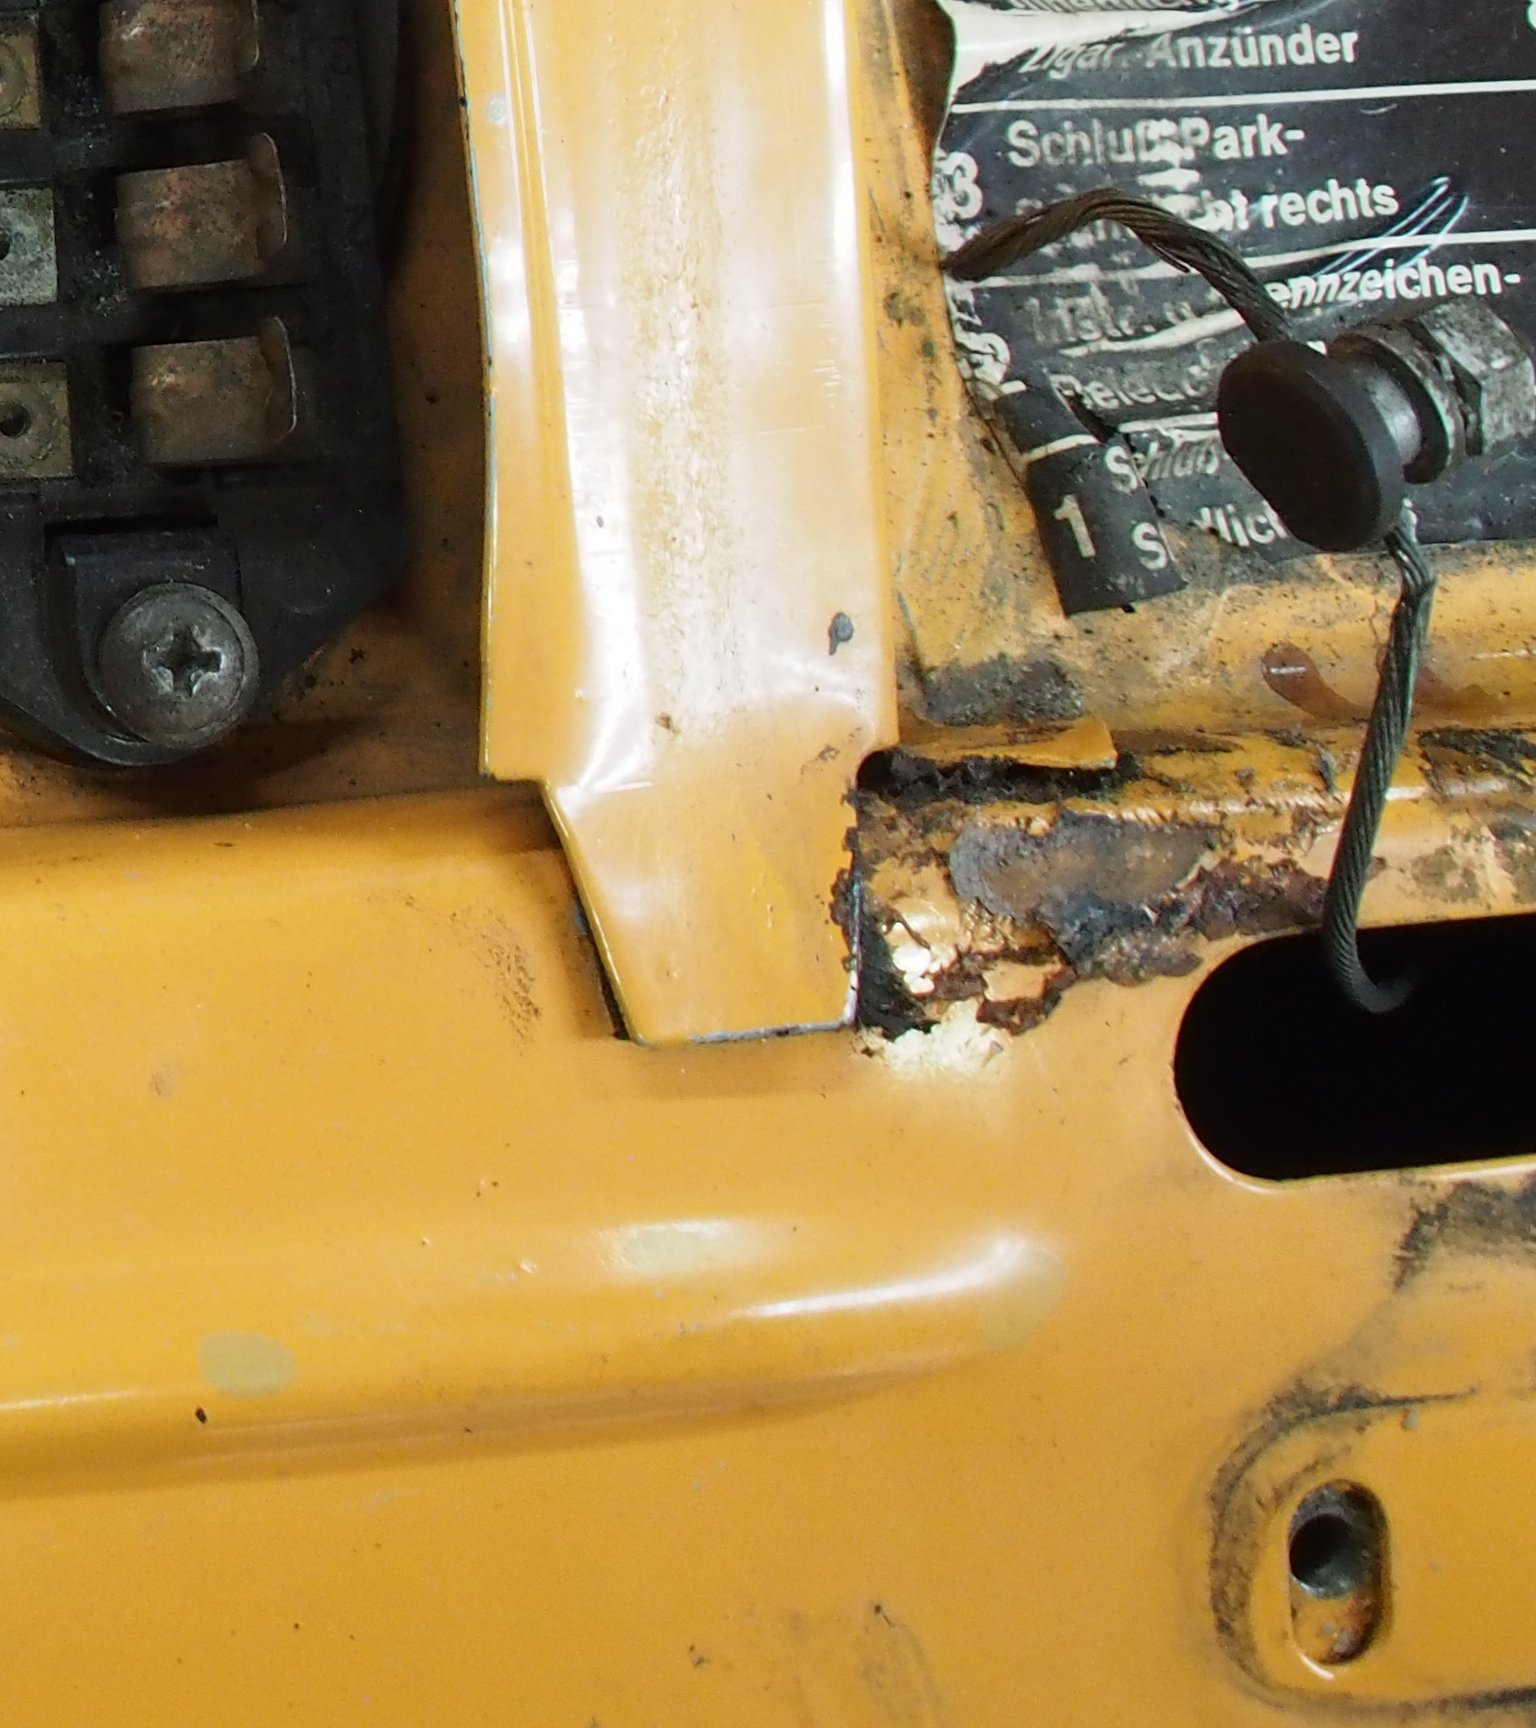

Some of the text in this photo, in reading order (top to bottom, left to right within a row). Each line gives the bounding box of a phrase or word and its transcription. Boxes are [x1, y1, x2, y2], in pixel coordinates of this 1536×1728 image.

[1144, 22, 1360, 70] Anzünder
[1260, 177, 1401, 230] rechts
[1265, 258, 1522, 309] ennzeichen-
[1054, 494, 1100, 560] 1
